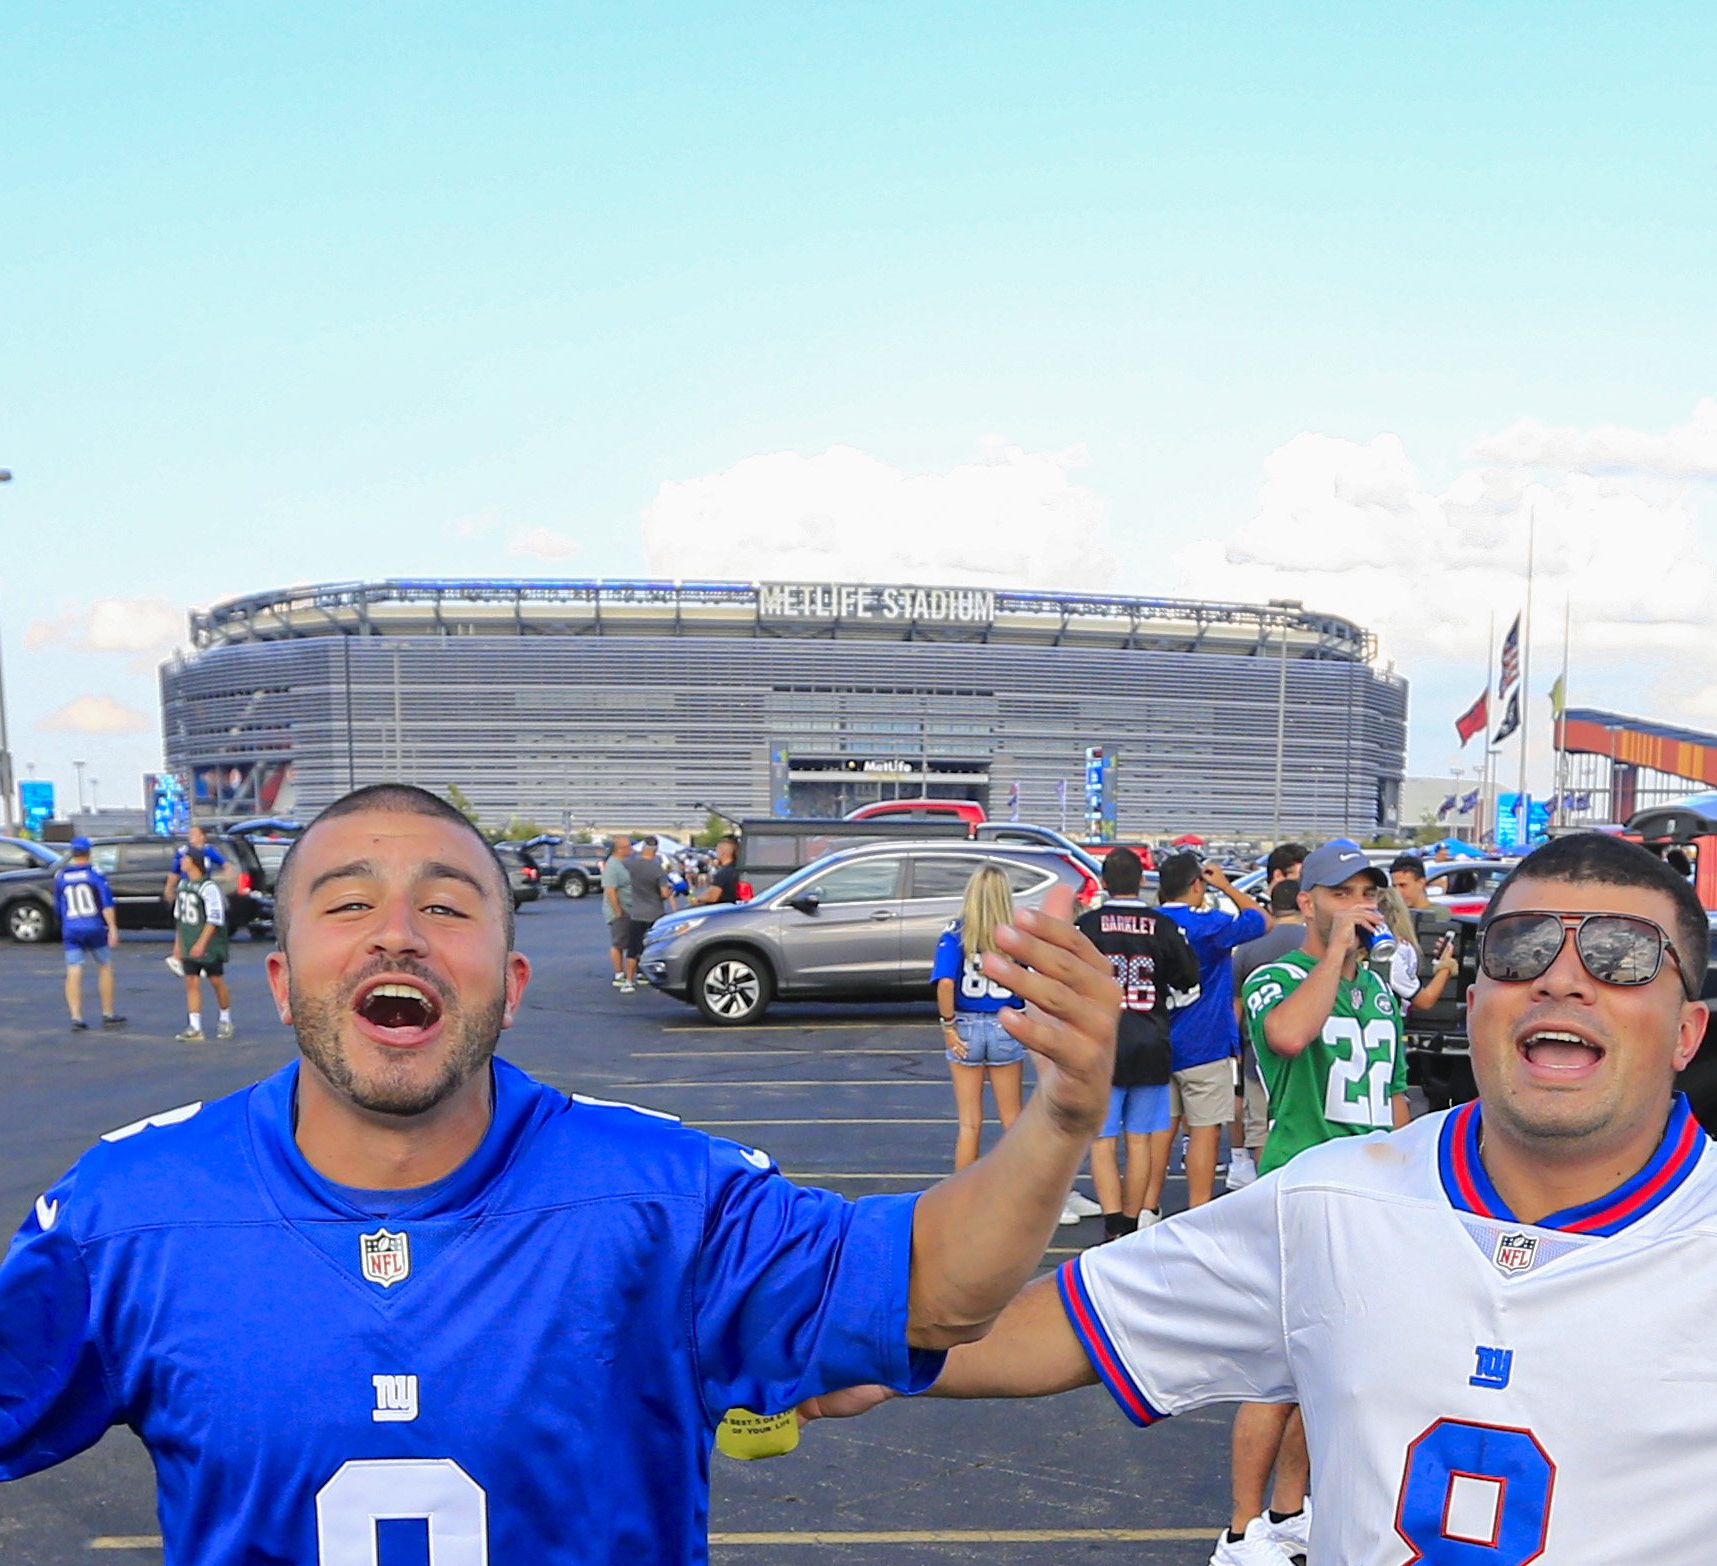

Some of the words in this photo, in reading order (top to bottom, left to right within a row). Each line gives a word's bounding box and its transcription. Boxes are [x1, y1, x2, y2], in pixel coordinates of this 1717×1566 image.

[760, 585, 872, 618] METLIFE
[884, 588, 994, 622] STADIUM
[863, 759, 913, 772] MetLife
[63, 883, 98, 919] 10
[1100, 914, 1157, 936] BARKLEY
[1321, 1015, 1396, 1127] 22
[369, 1252, 403, 1276] NFL
[1498, 1247, 1529, 1267] NFL
[730, 1418, 752, 1426] BEST
[748, 1426, 771, 1434] YOUR
